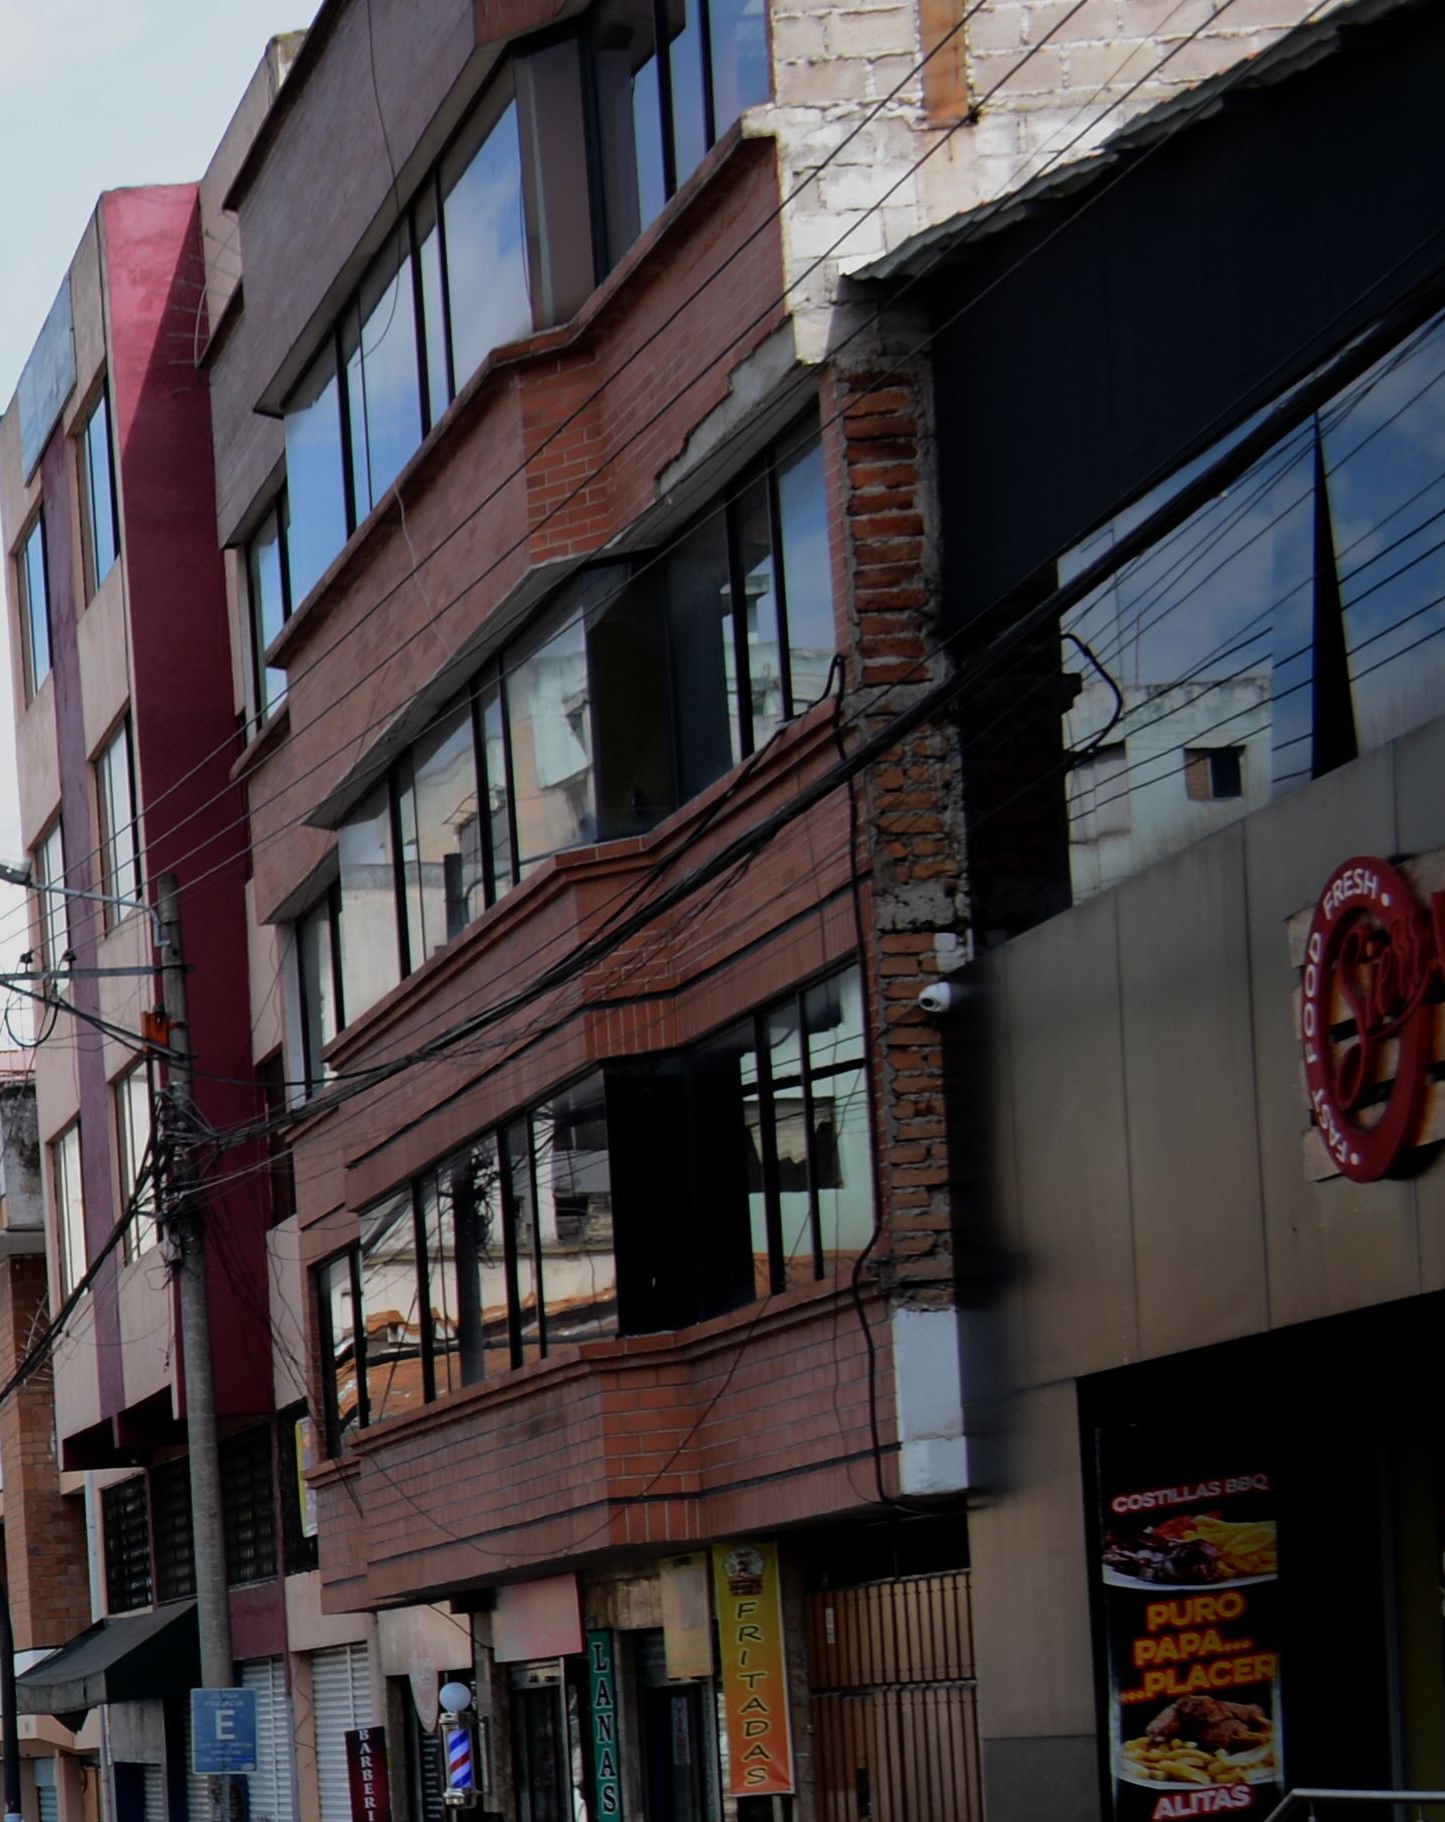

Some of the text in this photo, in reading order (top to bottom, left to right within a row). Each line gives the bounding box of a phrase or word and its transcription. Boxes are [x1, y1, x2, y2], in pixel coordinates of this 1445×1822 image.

[1322, 867, 1380, 921] FRESH
[1112, 1473, 1270, 1513] COSTILLAS BBQ
[1147, 1592, 1244, 1631] PURO
[736, 1601, 771, 1786] FRITADAS
[215, 1709, 235, 1741] E
[592, 1643, 618, 1815] LANAS
[1153, 1785, 1252, 1820] ALITAS
